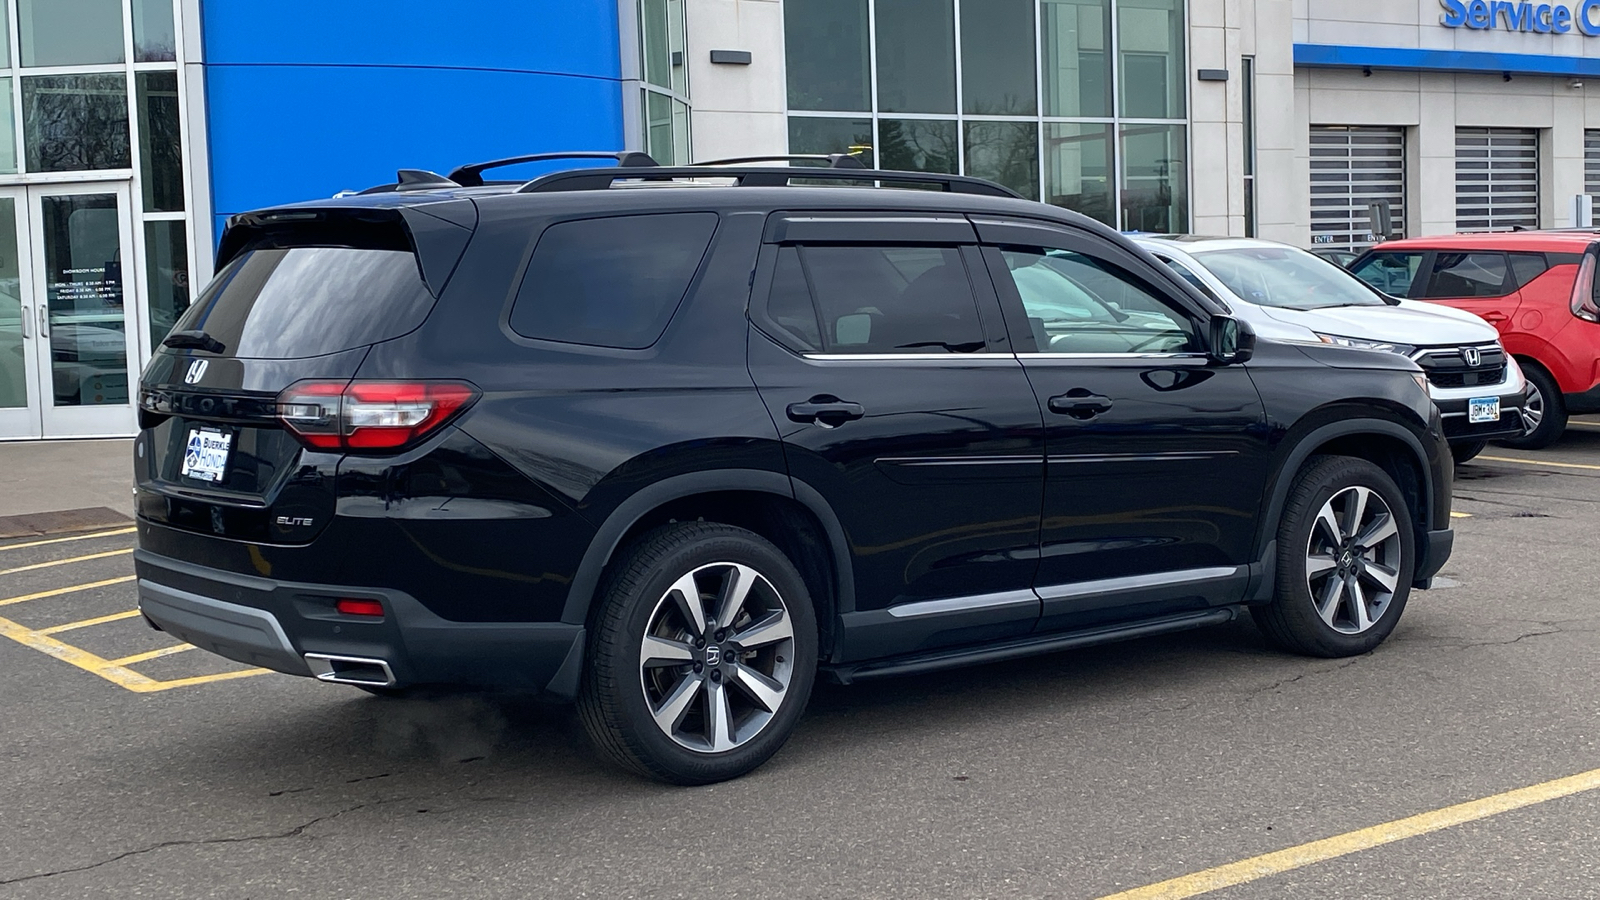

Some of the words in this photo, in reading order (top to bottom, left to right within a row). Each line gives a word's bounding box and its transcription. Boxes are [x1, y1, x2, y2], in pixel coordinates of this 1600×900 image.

[1440, 0, 1571, 33] Service
[1314, 235, 1334, 243] ENTER
[203, 437, 230, 451] BUERKLE
[199, 449, 227, 469] HONDA
[276, 516, 313, 526] ELITE
